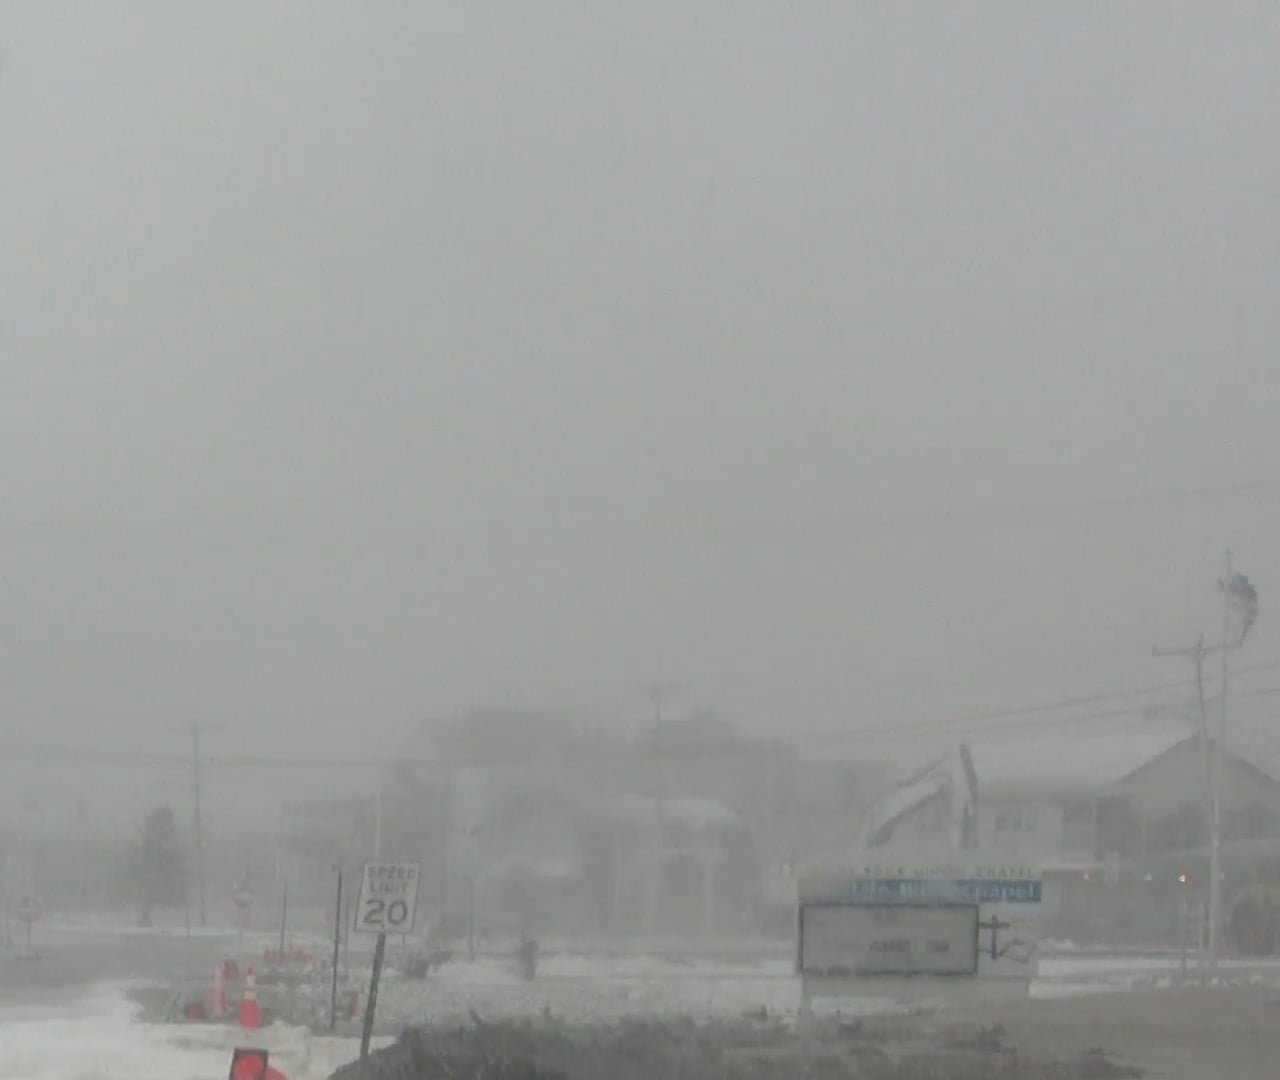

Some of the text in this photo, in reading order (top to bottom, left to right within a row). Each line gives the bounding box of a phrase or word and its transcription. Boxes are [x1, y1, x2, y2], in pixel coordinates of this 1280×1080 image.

[367, 865, 416, 880] SPEED
[976, 866, 1033, 878] CHAPEL
[369, 881, 409, 893] LIMIT
[362, 897, 409, 926] 20
